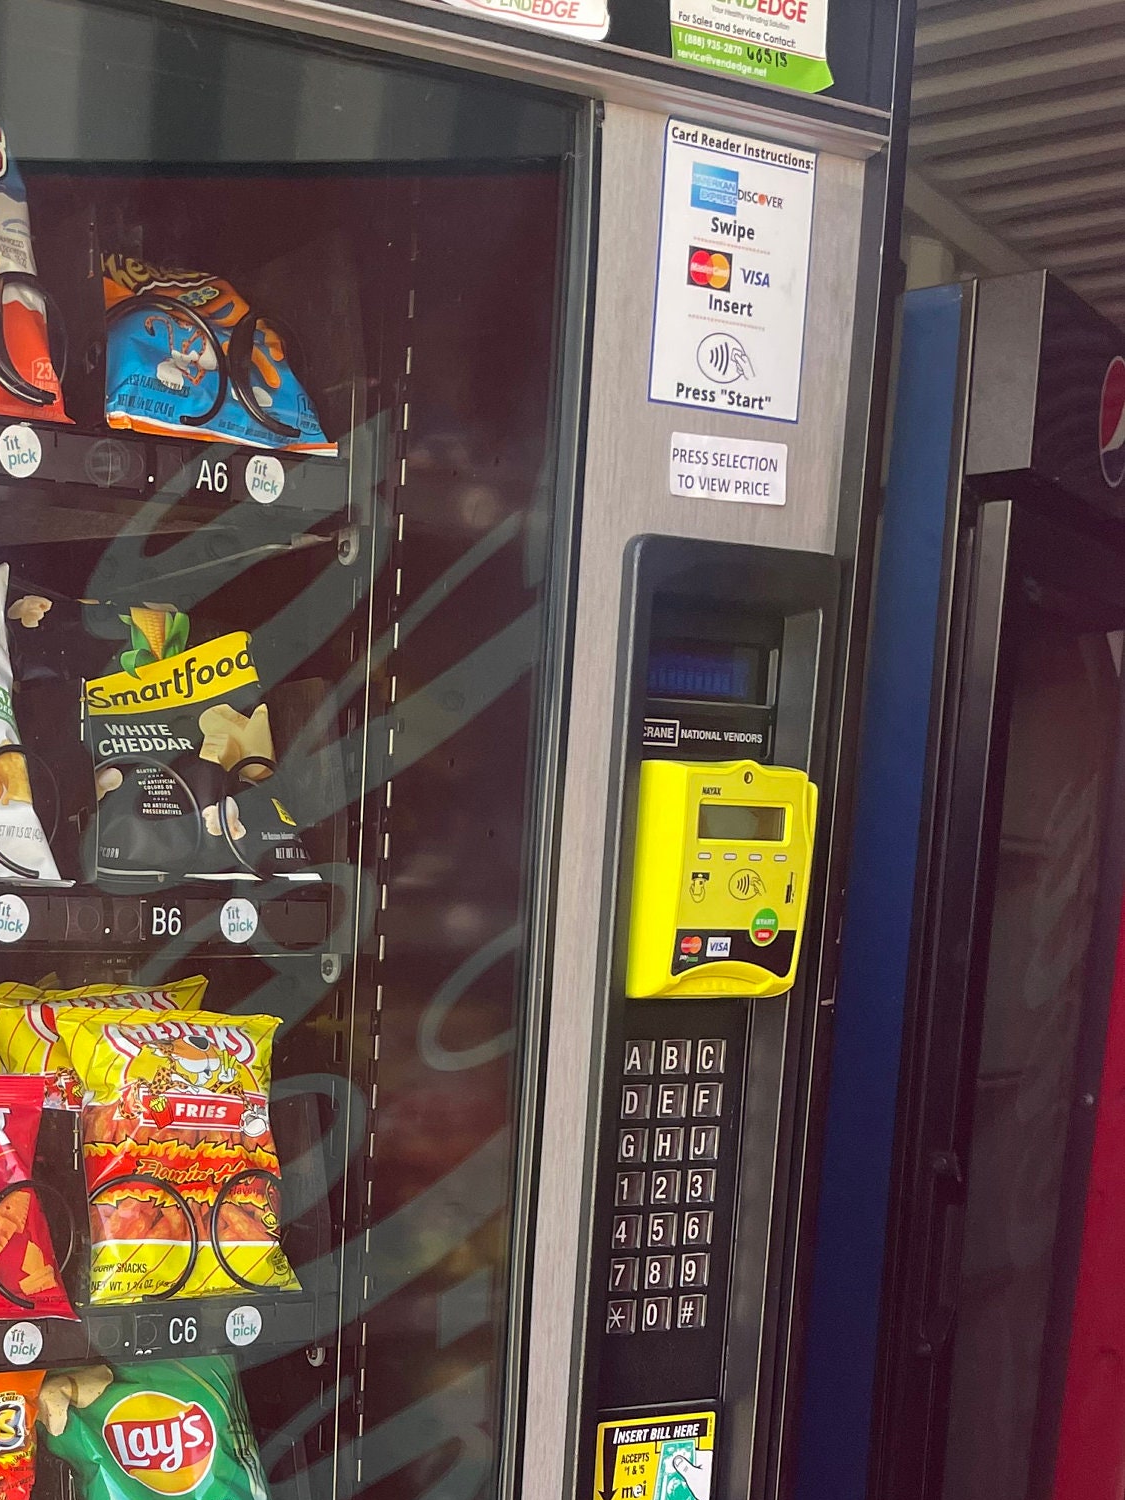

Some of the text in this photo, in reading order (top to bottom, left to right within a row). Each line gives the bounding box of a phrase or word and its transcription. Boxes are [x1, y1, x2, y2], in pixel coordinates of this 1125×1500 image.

[679, 11, 761, 40] For Sales and Service
[671, 126, 814, 170] Card Reader Instructions:
[711, 217, 755, 242] Swipe
[740, 267, 770, 287] VISA
[708, 295, 753, 317] Insert
[676, 382, 771, 410] Press "Start"
[8, 448, 38, 468] pick
[672, 448, 777, 472] PRESS SELECTION
[195, 459, 228, 492] A6
[251, 476, 278, 495] pick
[678, 475, 769, 496] TO VIEW PRICE
[88, 649, 255, 708] Smartfood
[105, 723, 173, 737] WHITE
[681, 729, 762, 743] NATIONAL VENDORS
[98, 738, 194, 756] CHEDDAR
[702, 787, 721, 795] NAYAX
[151, 906, 182, 936] B6
[226, 918, 253, 936] pick
[710, 942, 728, 952] VISA
[627, 1046, 713, 1070] A B C
[175, 1105, 227, 1119] FRIES
[625, 1090, 709, 1114] D E F
[622, 1132, 706, 1157] G H J
[621, 1175, 702, 1200] 1 2 3
[616, 1217, 699, 1243] 4 5 6
[116, 1262, 147, 1274] SNACKS
[614, 1260, 696, 1286] 7 8 9
[646, 1304, 657, 1326] 0
[168, 1318, 197, 1344] C6
[232, 1324, 257, 1338] pick
[10, 1341, 37, 1357] pick
[112, 1411, 205, 1472] Lay's
[613, 1424, 699, 1444] INSERT BILL HERE
[621, 1452, 649, 1464] ACCEPTS
